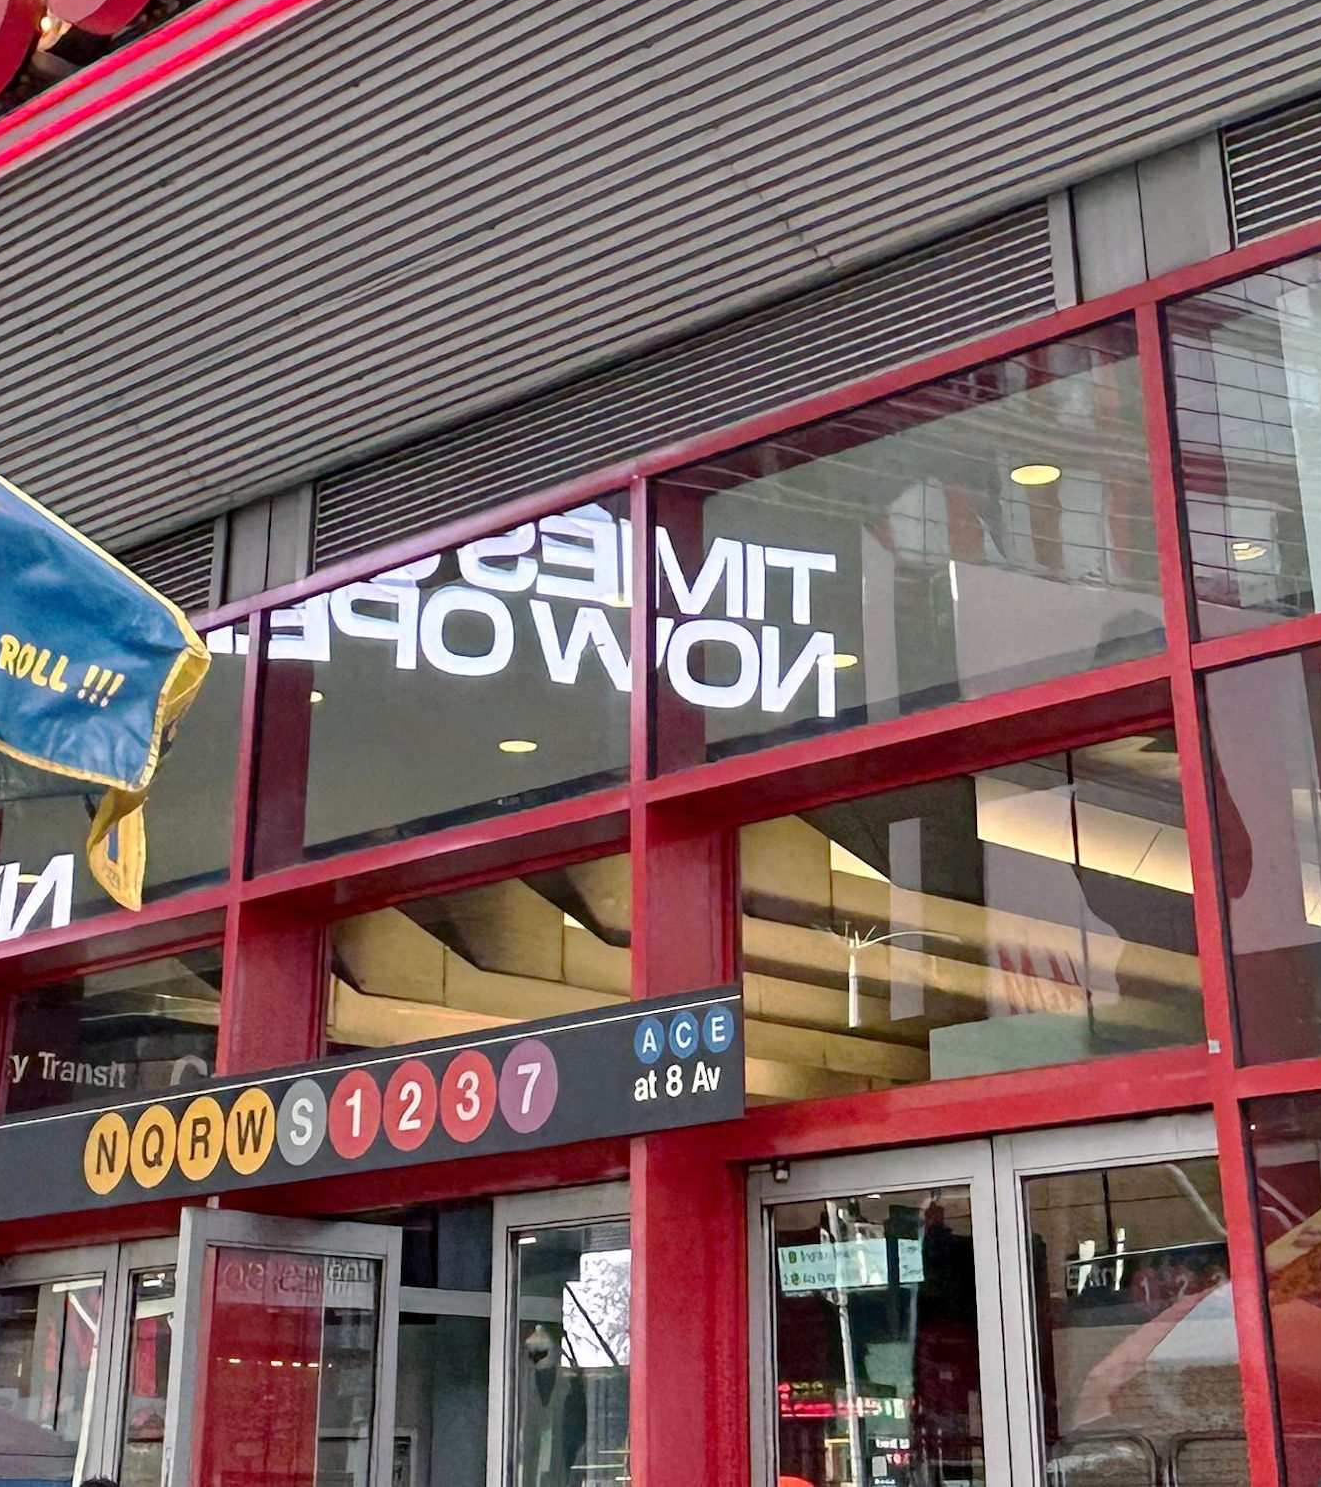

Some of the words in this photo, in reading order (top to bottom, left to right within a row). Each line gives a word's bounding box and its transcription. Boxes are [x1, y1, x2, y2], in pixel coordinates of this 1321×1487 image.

[76, 664, 126, 708] !!!
[38, 1050, 127, 1089] Transit
[634, 1070, 658, 1103] at
[665, 1064, 683, 1099] 8
[691, 1060, 722, 1094] Av
[236, 1105, 268, 1156] W
[289, 1097, 315, 1147] S
[397, 1080, 423, 1132] 2
[455, 1069, 480, 1122] 3
[516, 1061, 542, 1116] 7
